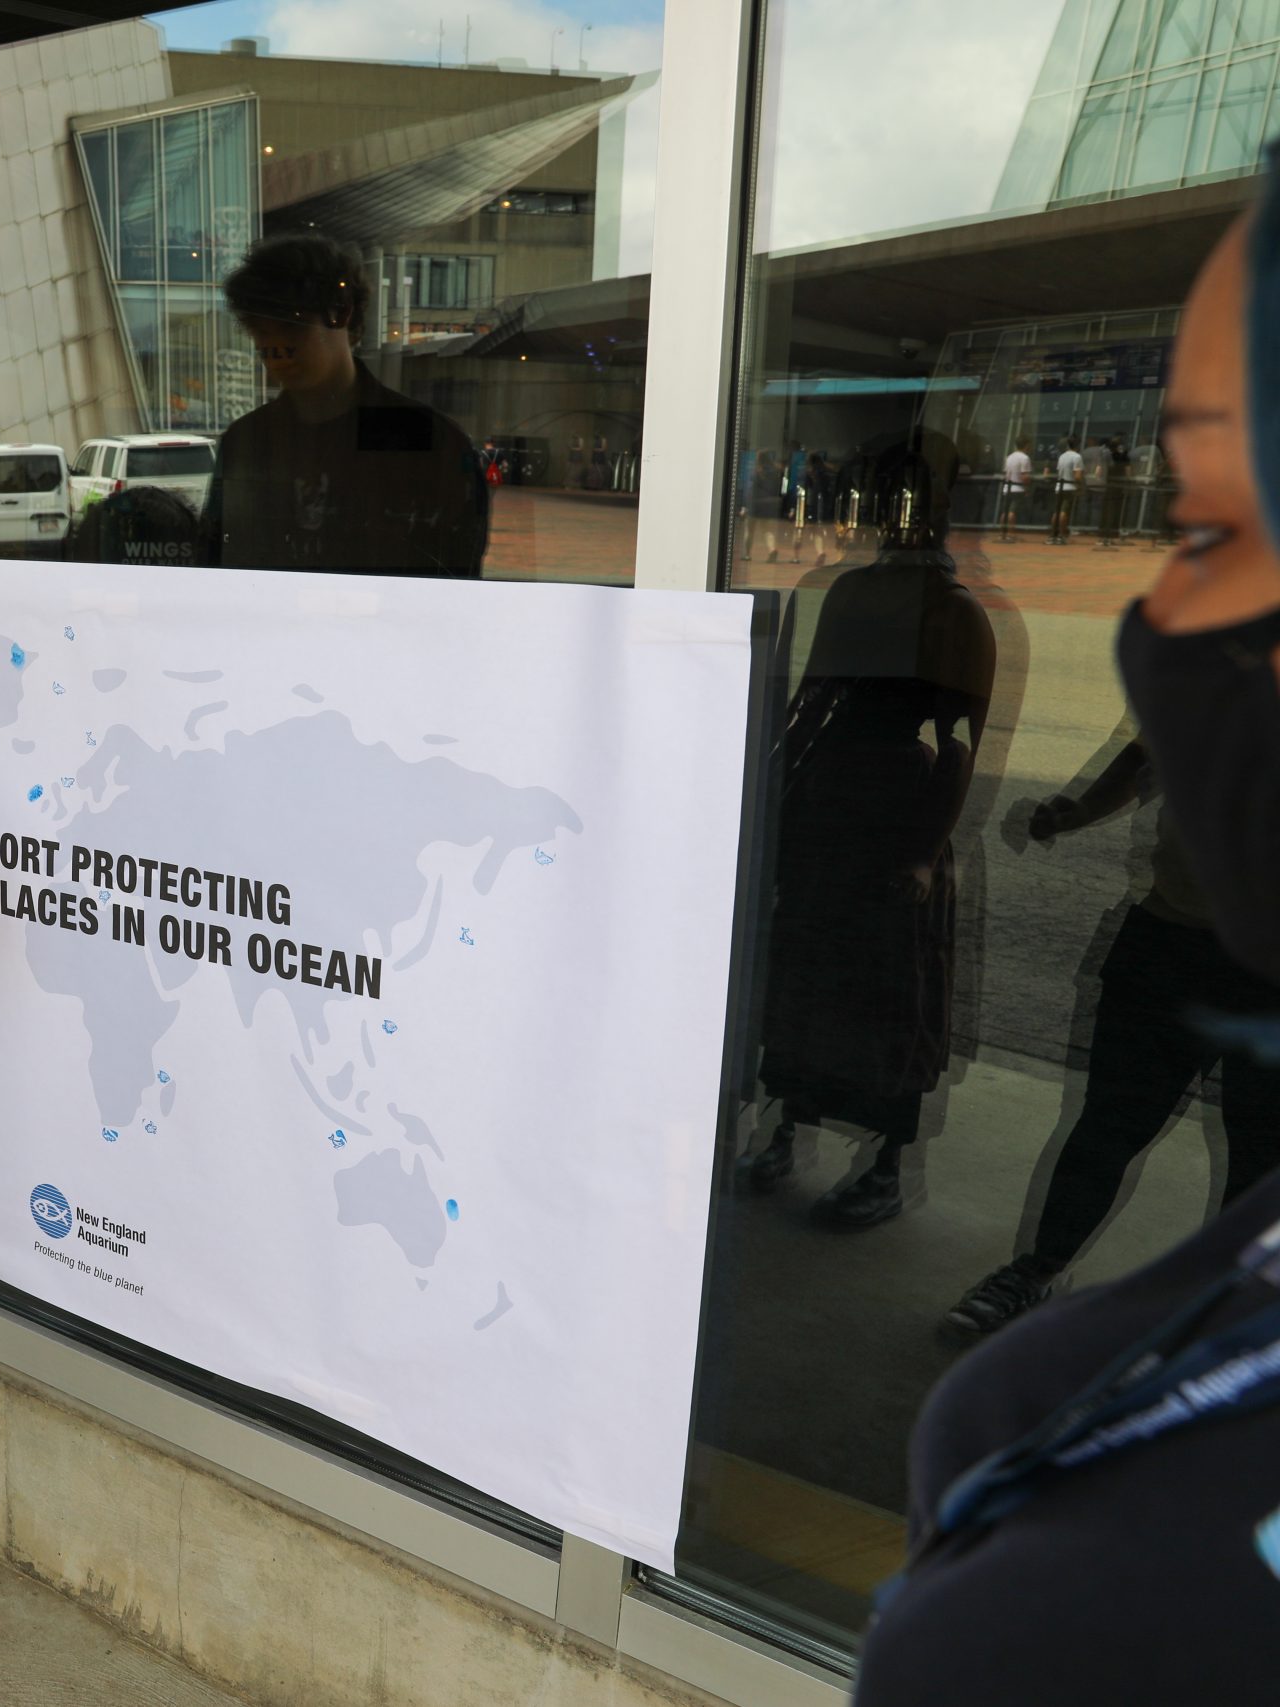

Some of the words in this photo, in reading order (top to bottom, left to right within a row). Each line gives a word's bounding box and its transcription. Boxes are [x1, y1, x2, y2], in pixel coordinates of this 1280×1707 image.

[124, 542, 192, 558] WINGS
[72, 846, 291, 926] PROTECTING
[112, 904, 146, 947] IN
[159, 915, 232, 966] OUR
[247, 934, 382, 1000] OCEAN
[76, 1207, 100, 1227] New
[102, 1217, 146, 1244] England
[78, 1226, 128, 1257] Aquarium
[34, 1241, 75, 1269] Protecting
[78, 1260, 92, 1274] the
[94, 1267, 113, 1283] blue
[115, 1278, 144, 1296] planet
